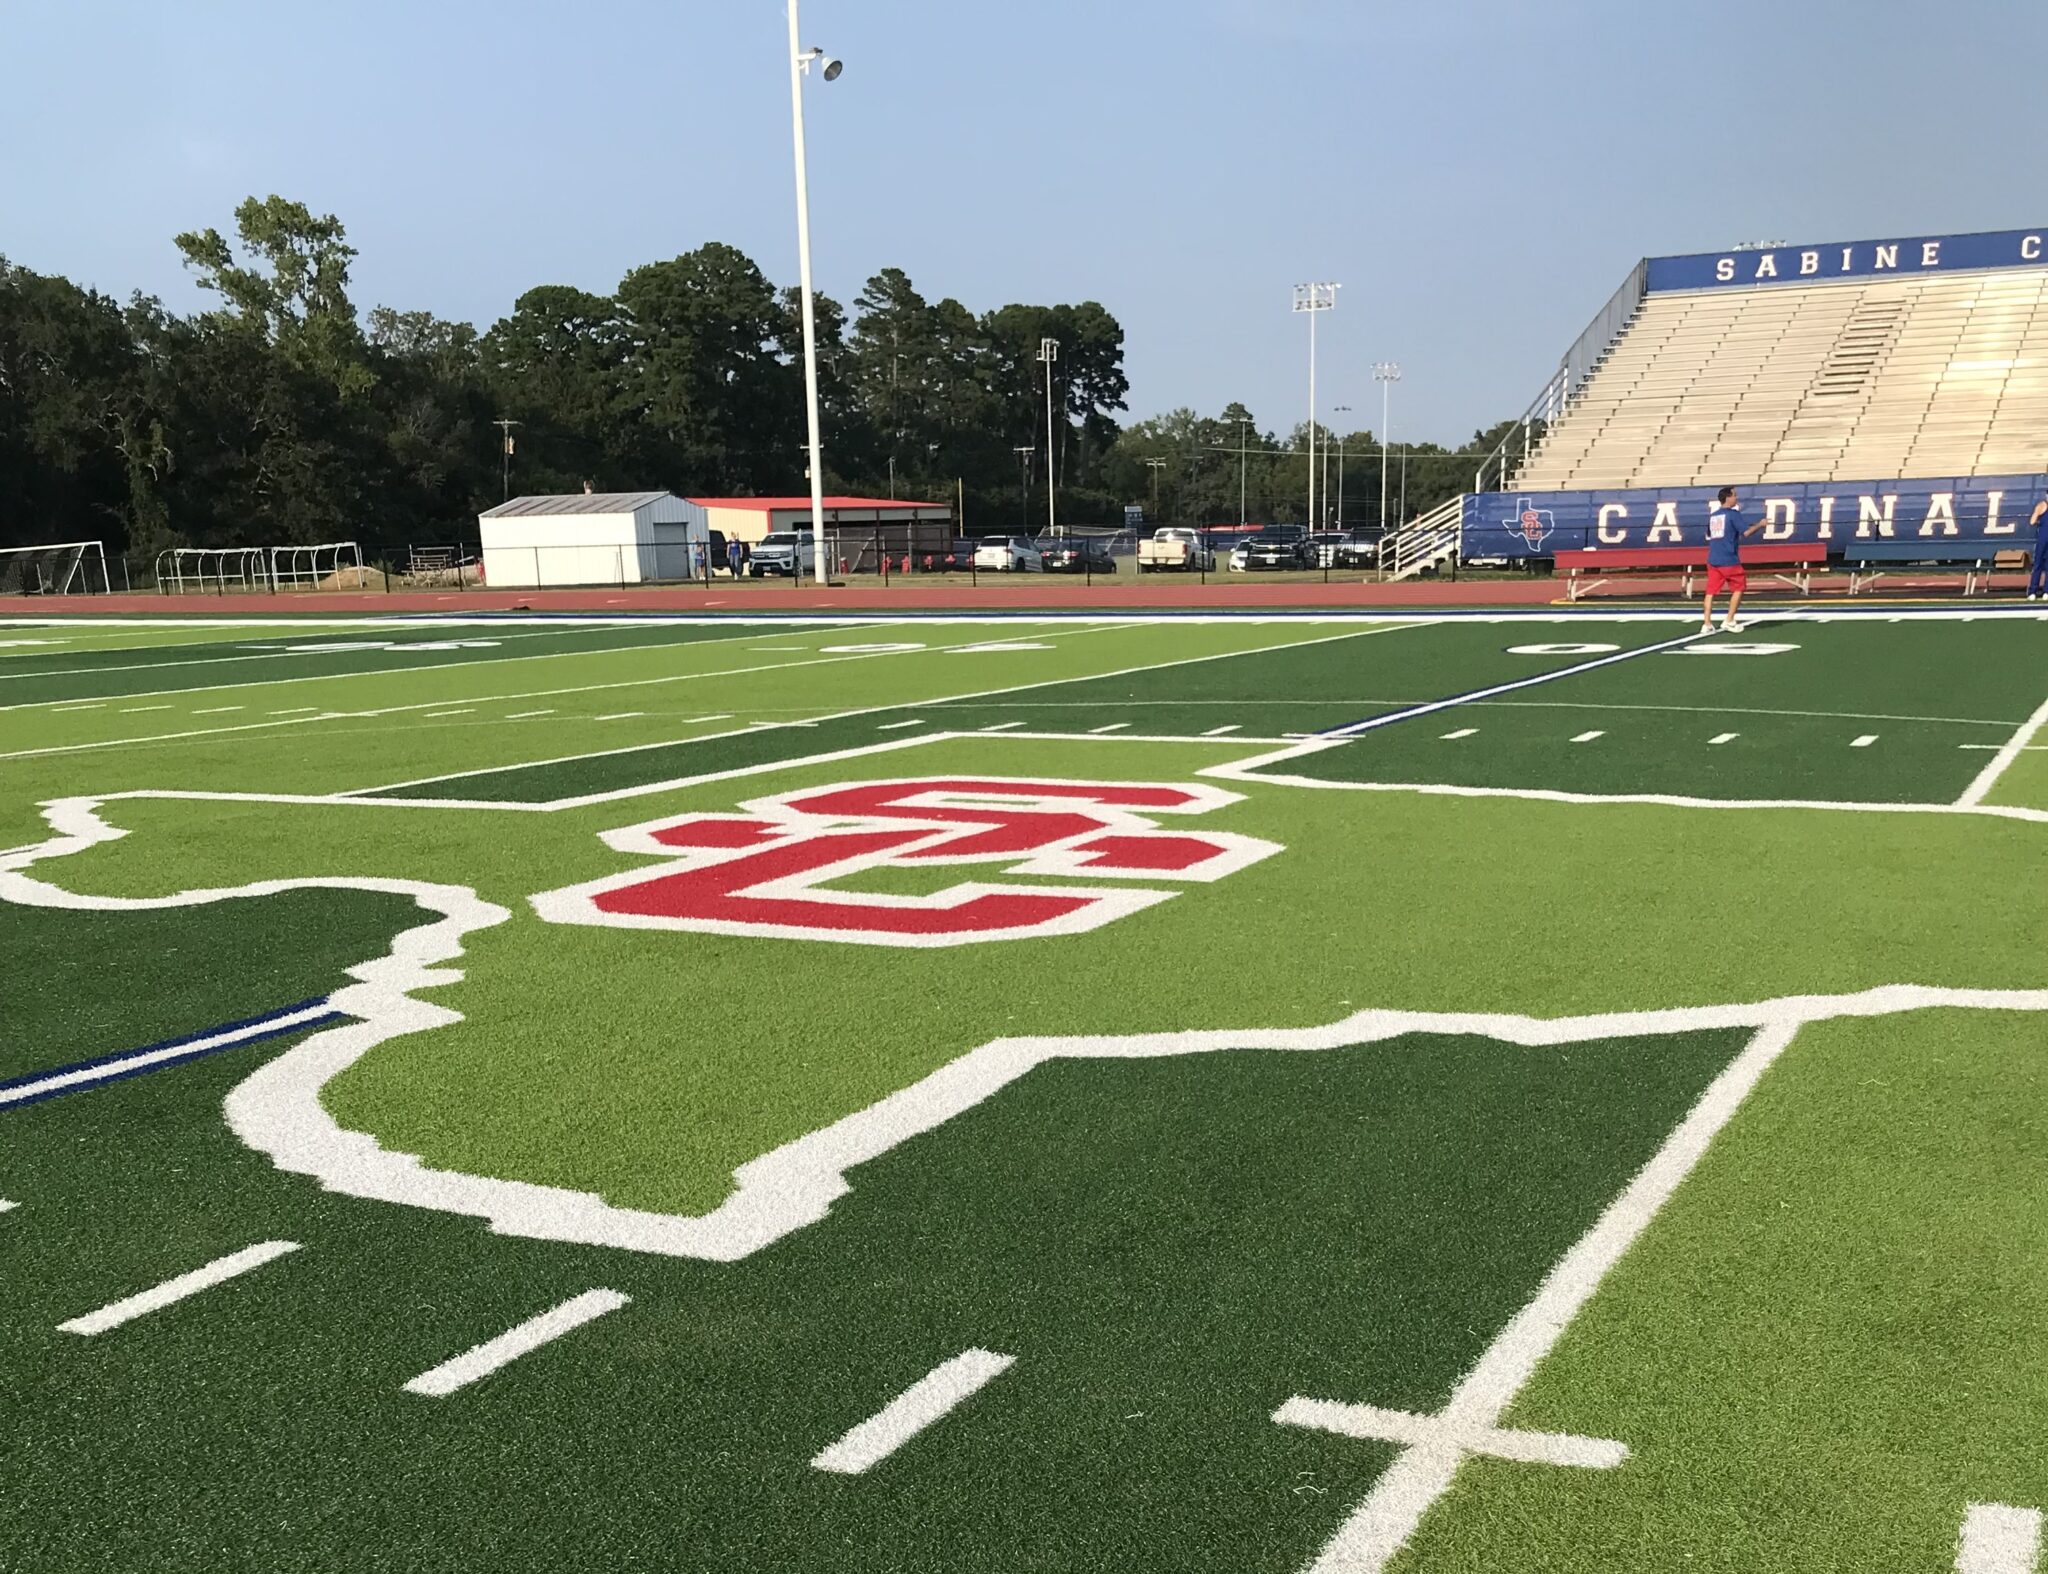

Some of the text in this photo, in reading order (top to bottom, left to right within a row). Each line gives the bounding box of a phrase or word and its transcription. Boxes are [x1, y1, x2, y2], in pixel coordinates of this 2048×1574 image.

[1716, 236, 2041, 281] SABINE C
[1597, 491, 2016, 544] CADINAL
